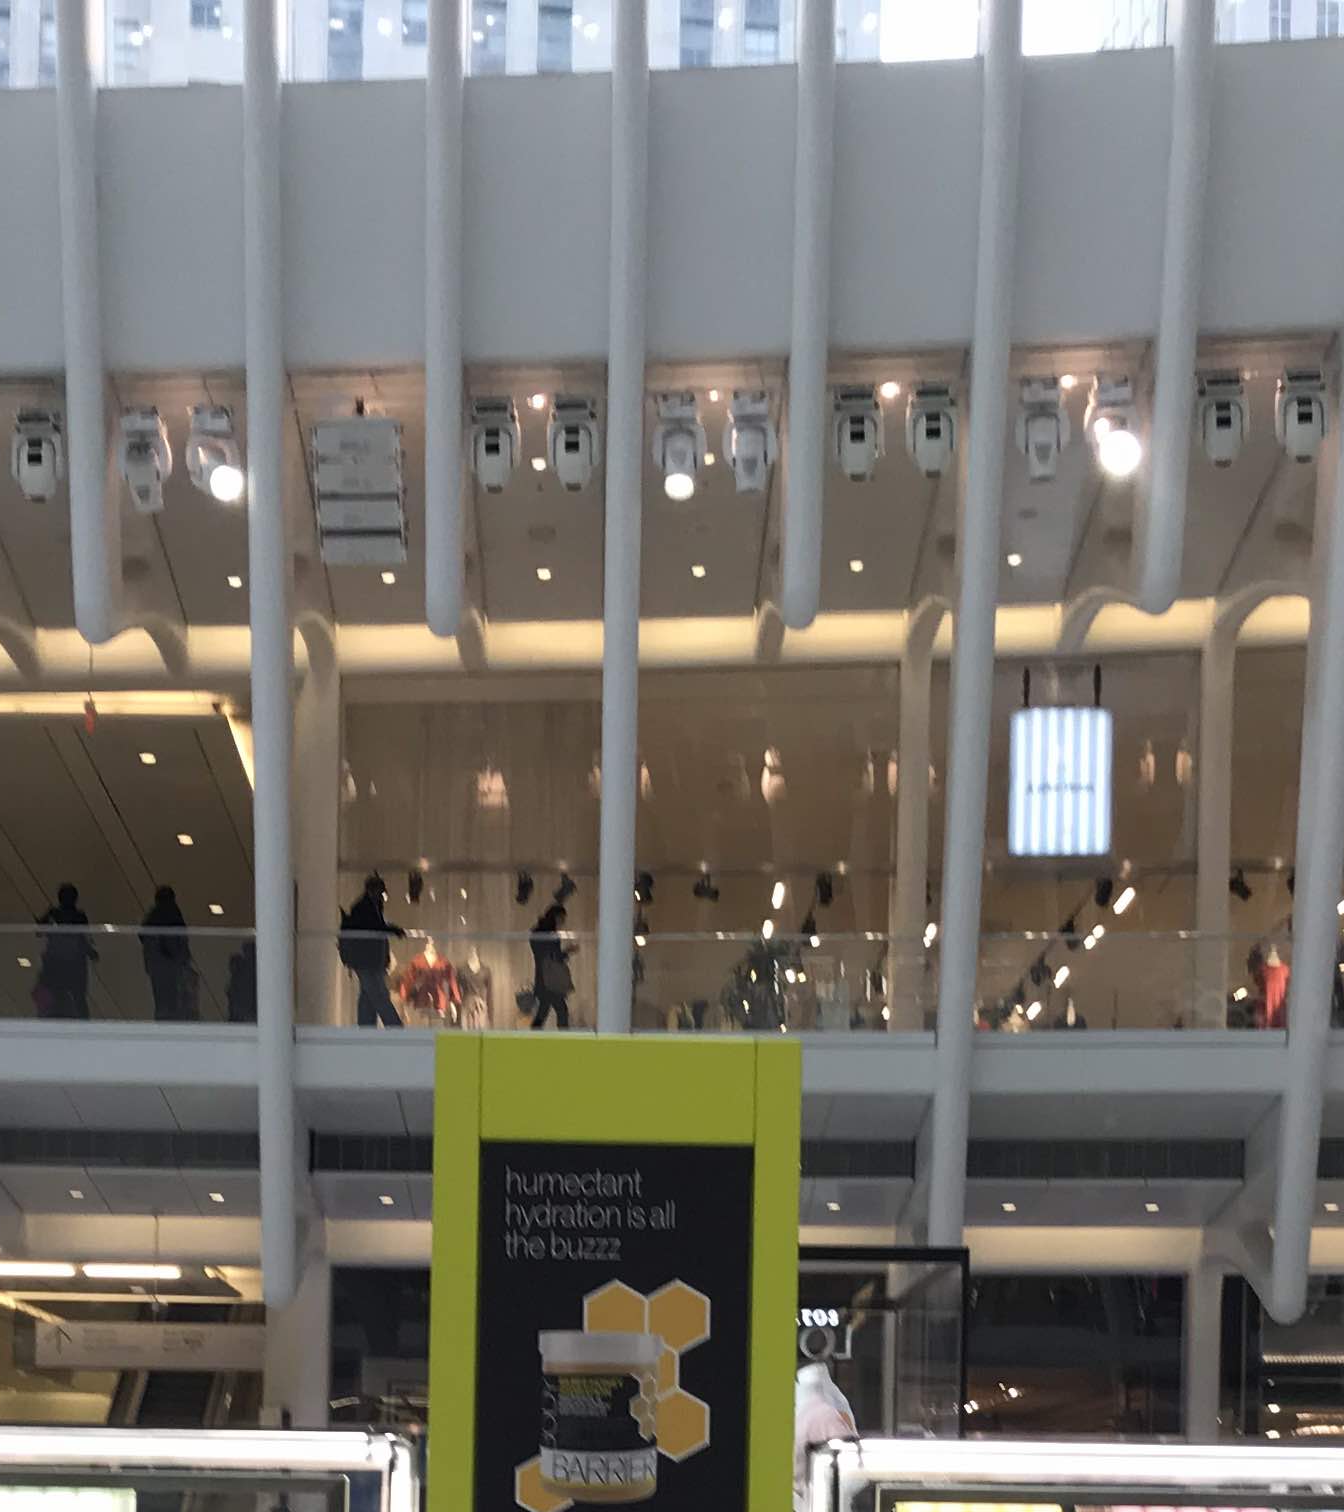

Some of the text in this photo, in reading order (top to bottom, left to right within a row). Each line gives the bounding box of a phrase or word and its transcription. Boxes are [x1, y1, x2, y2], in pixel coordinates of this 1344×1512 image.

[504, 1164, 643, 1198] humectant
[504, 1197, 677, 1235] hydration is all
[504, 1229, 545, 1260] the
